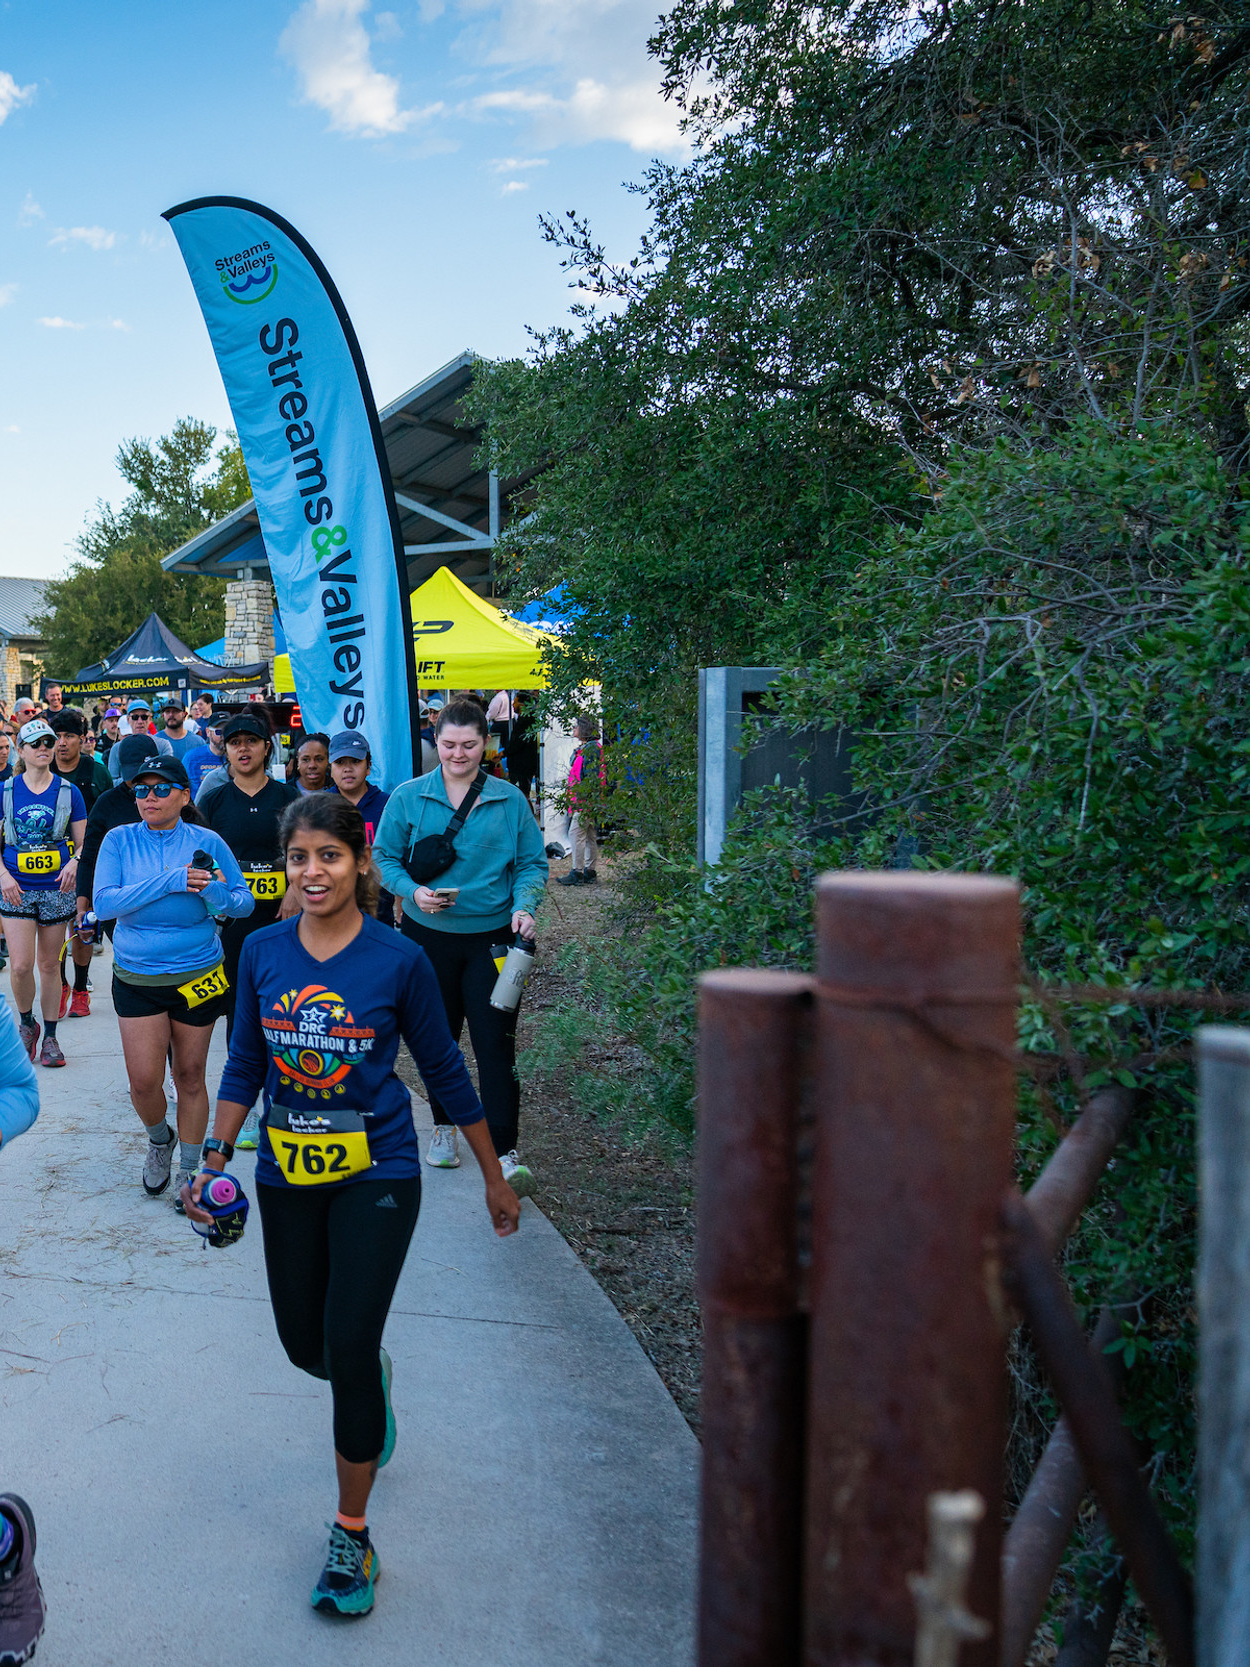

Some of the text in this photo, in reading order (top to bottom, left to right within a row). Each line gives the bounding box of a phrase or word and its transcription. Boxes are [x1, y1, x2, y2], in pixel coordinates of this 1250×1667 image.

[215, 241, 270, 271] Streams
[25, 855, 53, 870] 663
[245, 877, 278, 894] 763
[191, 970, 224, 999] 637
[299, 1021, 327, 1035] DRC
[280, 1031, 345, 1053] MARATHON
[348, 1037, 359, 1053] &
[359, 1037, 376, 1052] 5K
[287, 1112, 332, 1127] luke's
[281, 1140, 350, 1175] 762
